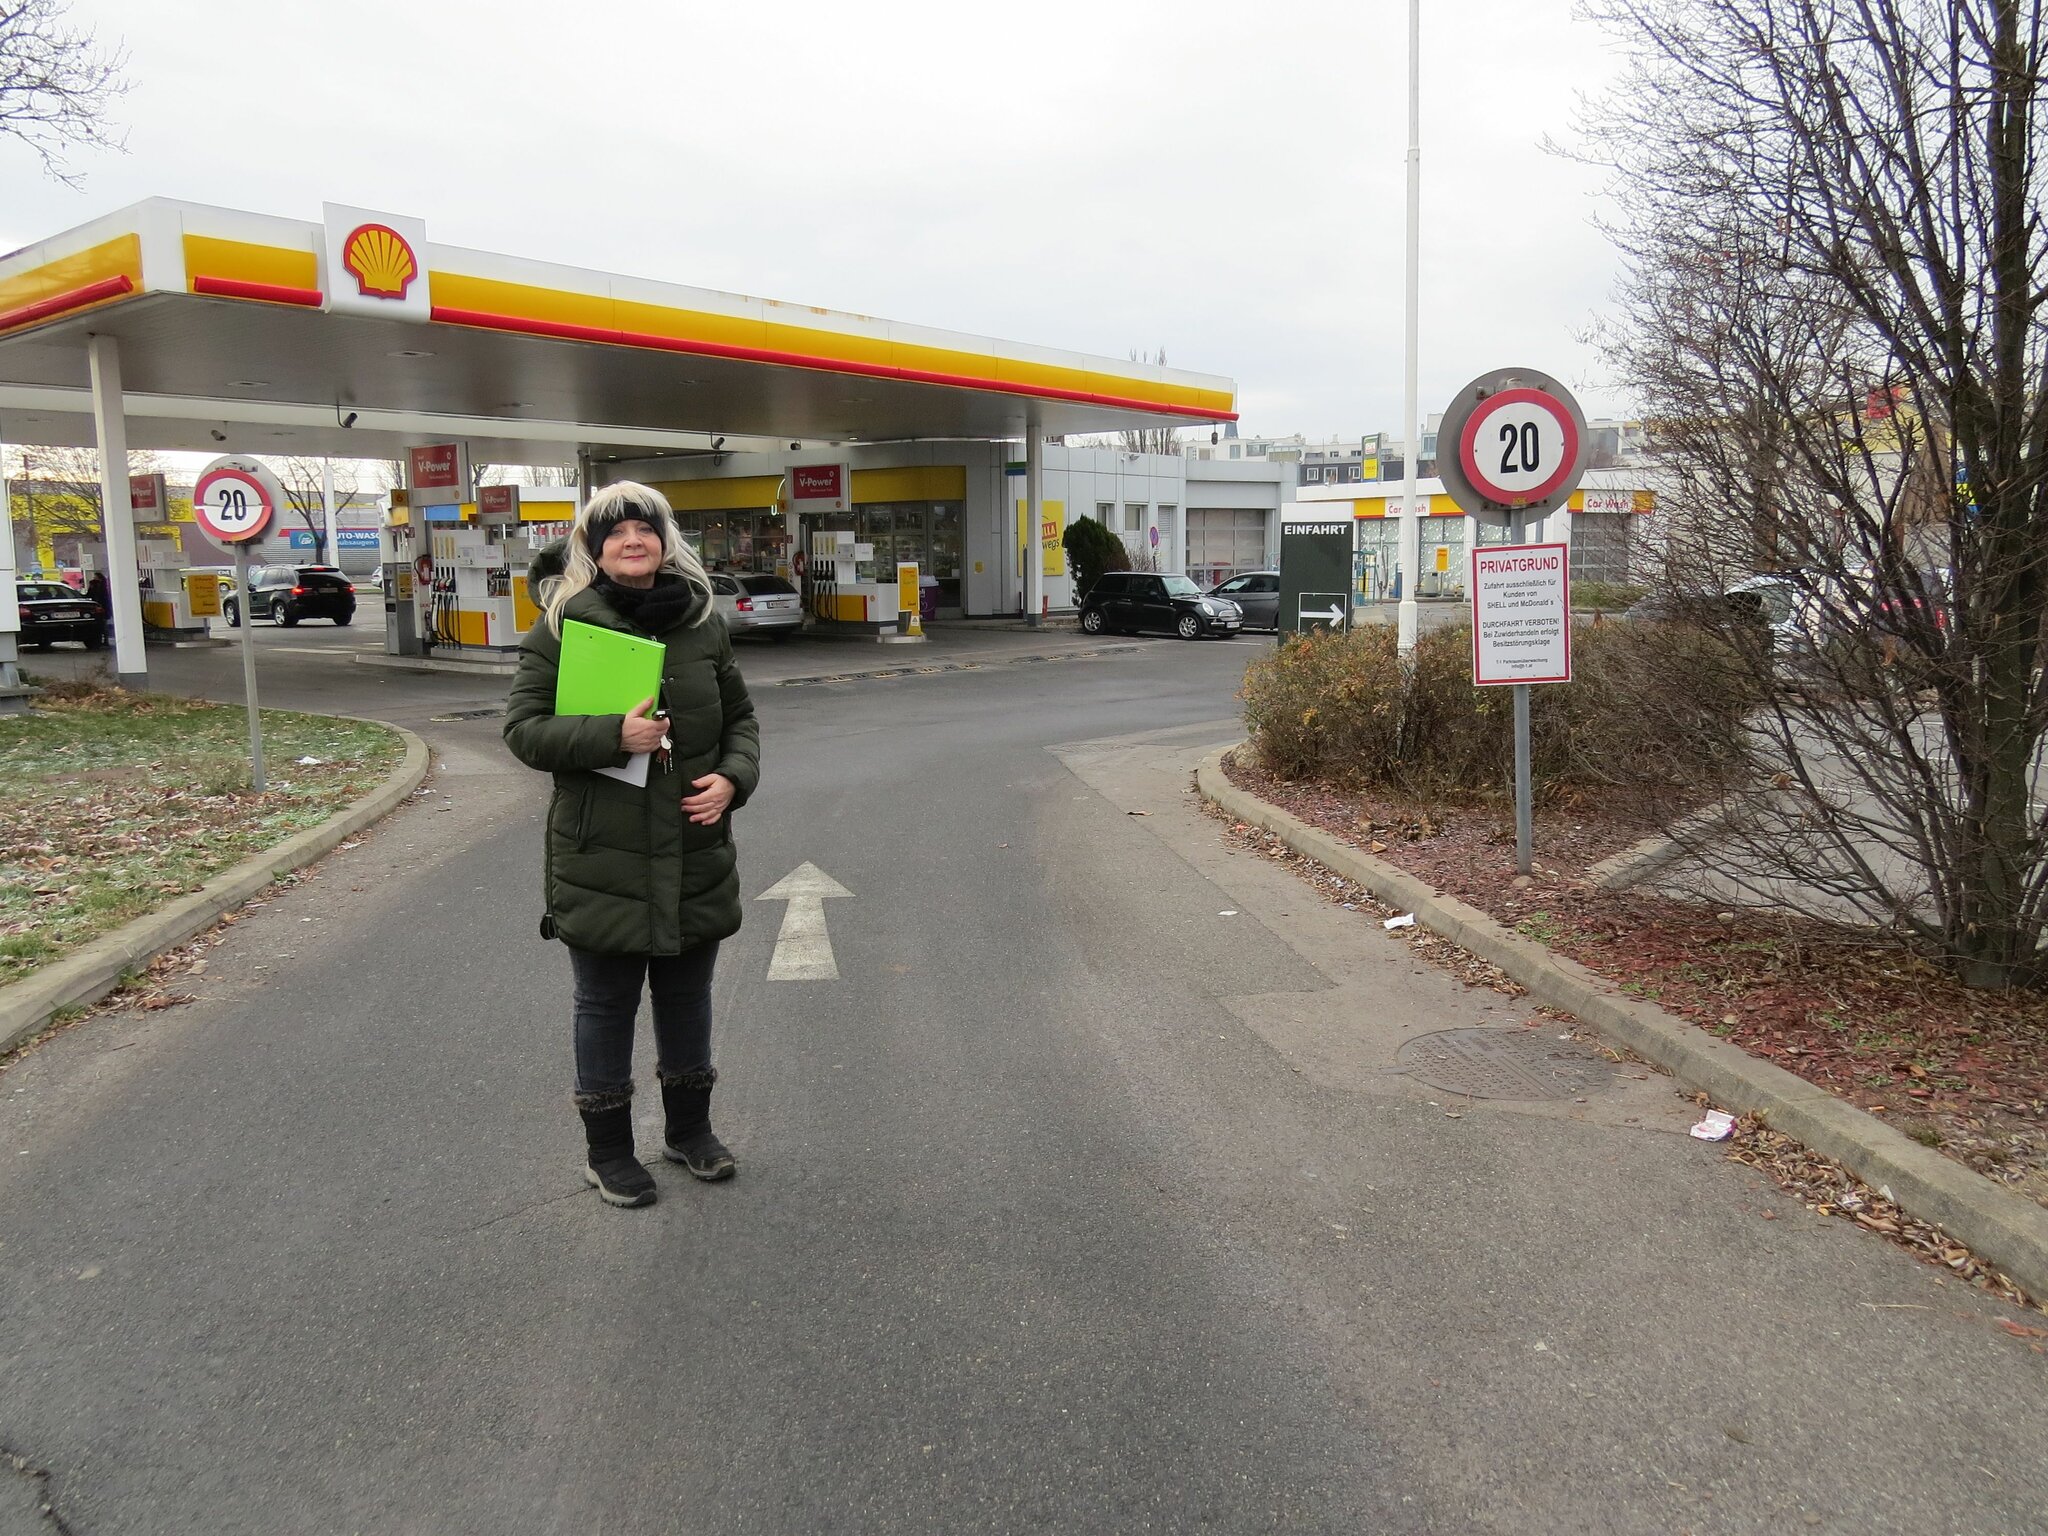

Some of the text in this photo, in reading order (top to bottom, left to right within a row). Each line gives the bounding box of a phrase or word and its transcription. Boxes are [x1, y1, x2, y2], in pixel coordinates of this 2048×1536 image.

[1499, 421, 1540, 474] 20
[418, 461, 451, 473] V-Power
[799, 477, 833, 488] V-Power
[219, 489, 248, 521] 20
[1587, 498, 1629, 509] Car Wash
[1388, 505, 1402, 514] Car
[1284, 524, 1348, 535] EINFAHRT
[1480, 556, 1559, 574] PRIVATGRUND
[1483, 578, 1557, 590] Zufahrt ausschließlich für
[1487, 601, 1507, 609] SHELL
[1482, 617, 1560, 629] DURCHFAHRT VERBOTEN!
[1483, 628, 1560, 639] Bei Zuwiderhandeln erfolgt
[1492, 638, 1551, 648] Besitzstörungsklage
